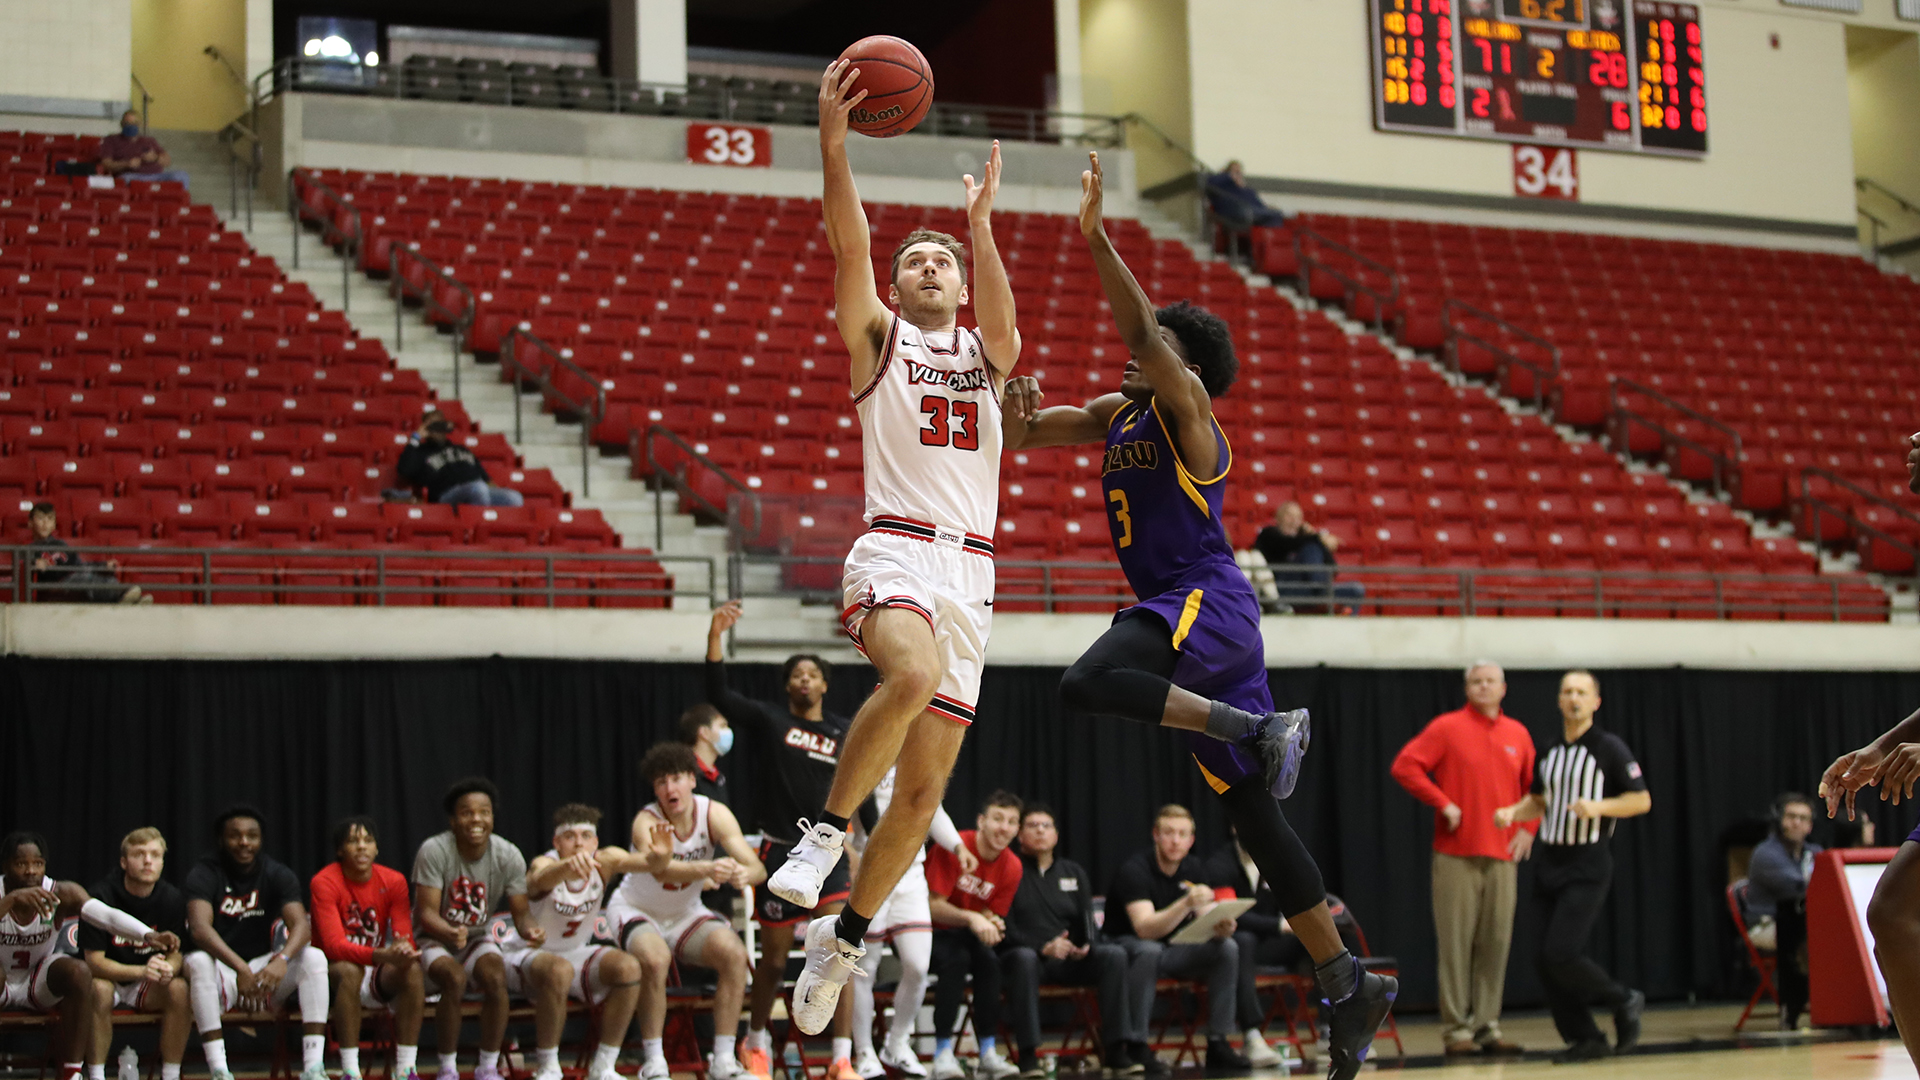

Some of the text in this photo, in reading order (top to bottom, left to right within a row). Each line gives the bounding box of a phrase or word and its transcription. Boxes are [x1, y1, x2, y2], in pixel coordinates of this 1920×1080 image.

[1473, 37, 1512, 75] 71
[1536, 48, 1555, 79] 2
[1589, 50, 1628, 88] 28
[1472, 87, 1630, 130] 2 6
[704, 126, 756, 165] 33
[1516, 146, 1577, 197] 34
[904, 359, 989, 391] VULCANS
[919, 395, 979, 451] 33
[1109, 488, 1133, 549] 3
